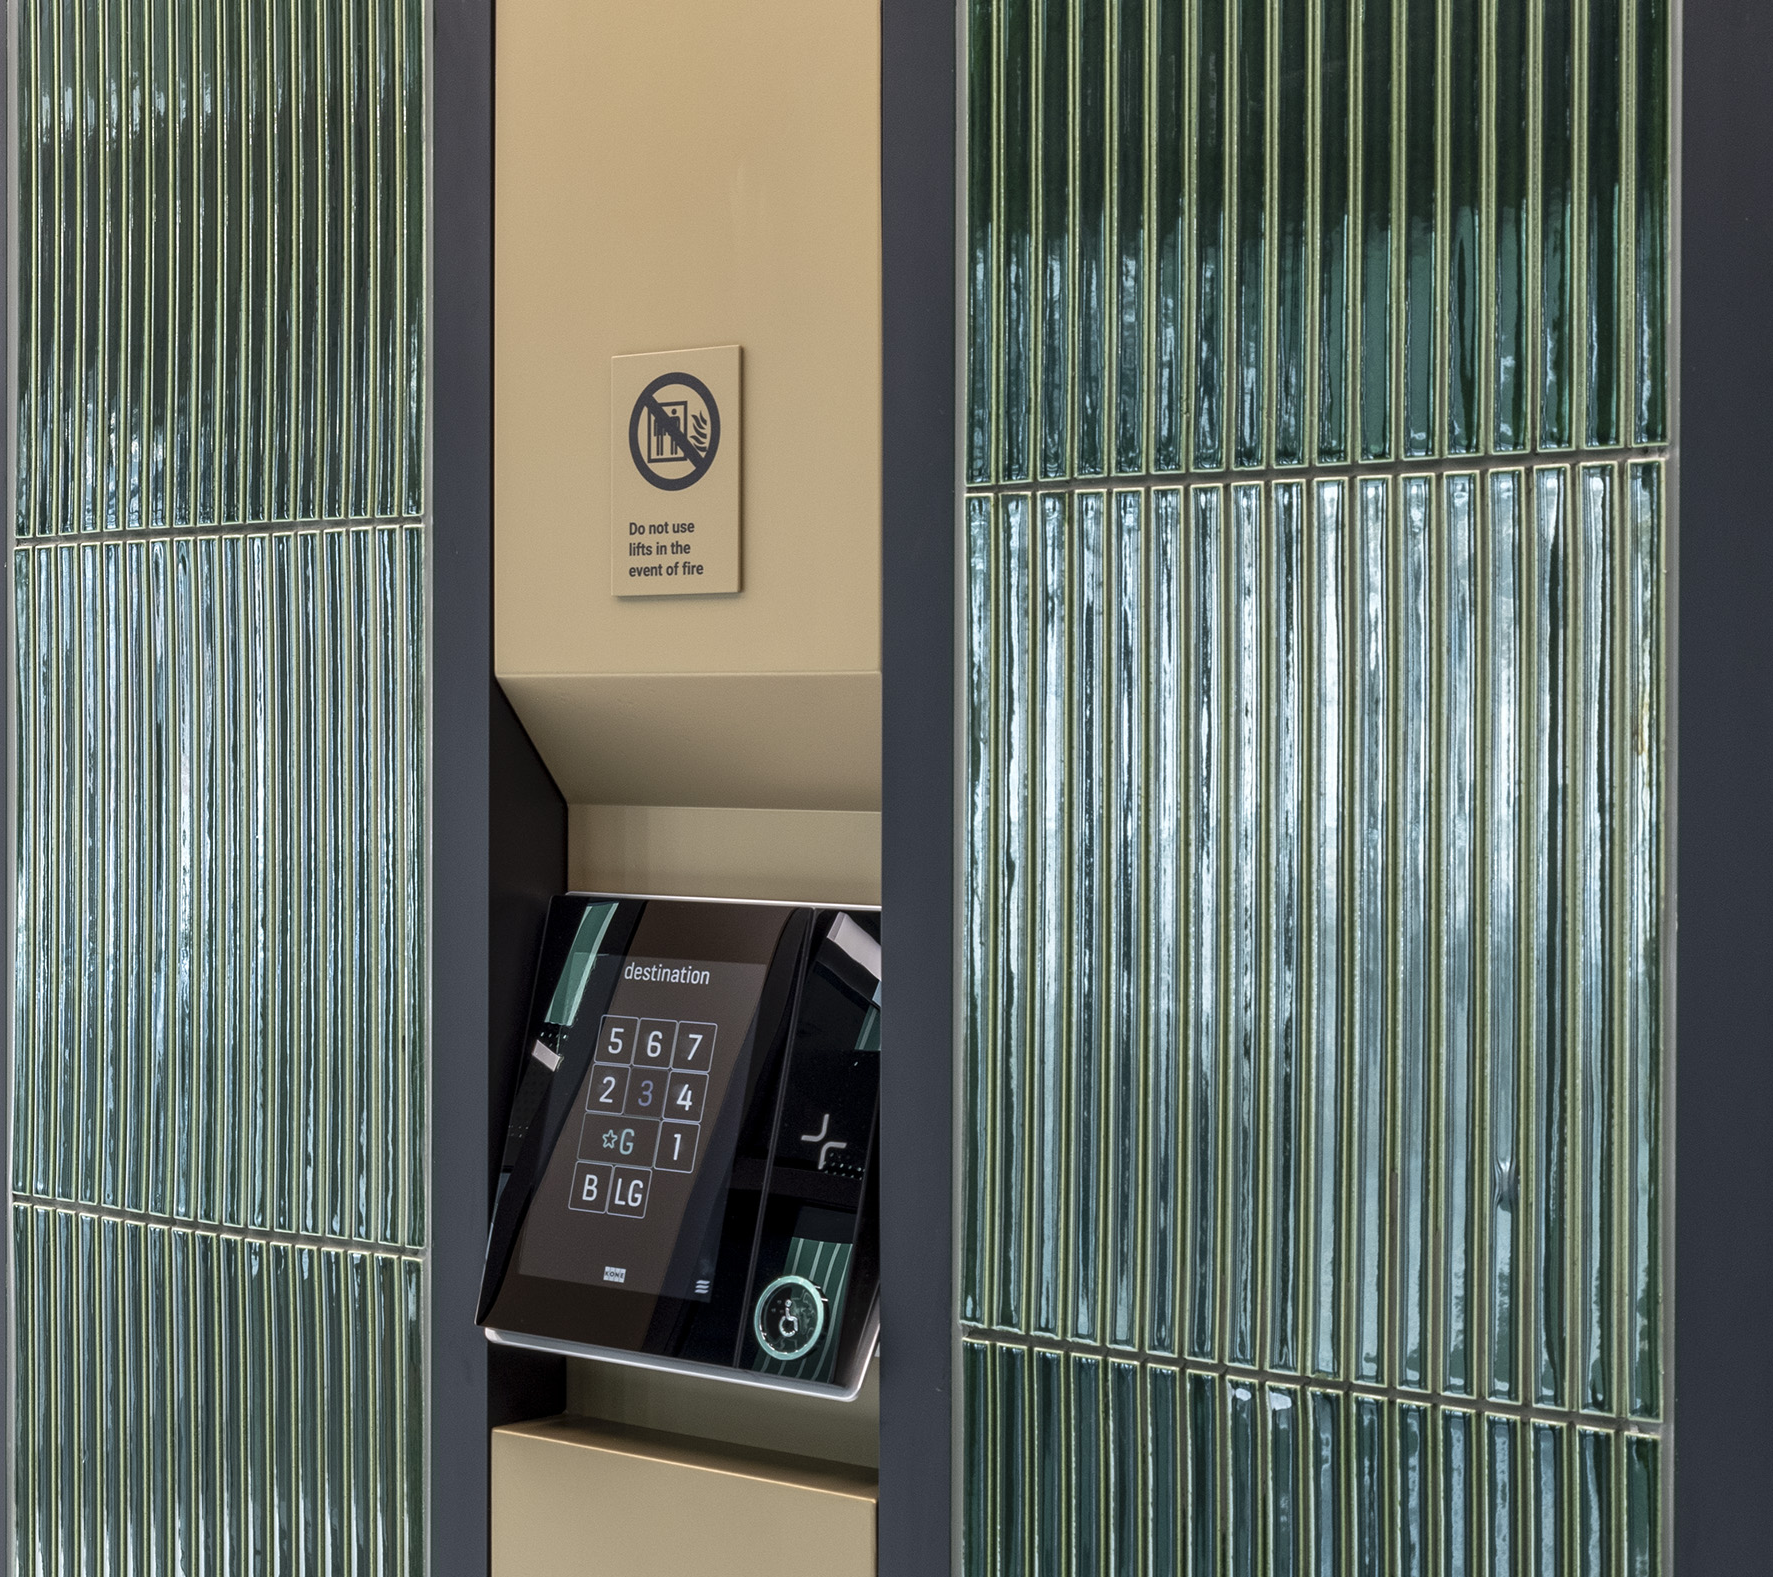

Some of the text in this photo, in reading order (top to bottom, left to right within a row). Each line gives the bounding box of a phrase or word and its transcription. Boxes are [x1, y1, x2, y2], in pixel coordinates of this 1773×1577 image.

[629, 522, 695, 535] Do not use
[629, 540, 690, 556] lifts in the
[629, 561, 704, 577] event of fire
[624, 961, 710, 986] destination
[609, 1028, 703, 1060] 5 6 7
[599, 1076, 693, 1111] 2 3 4
[672, 1134, 681, 1160] 1
[582, 1175, 644, 1207] B LG
[605, 1271, 624, 1279] KONE
